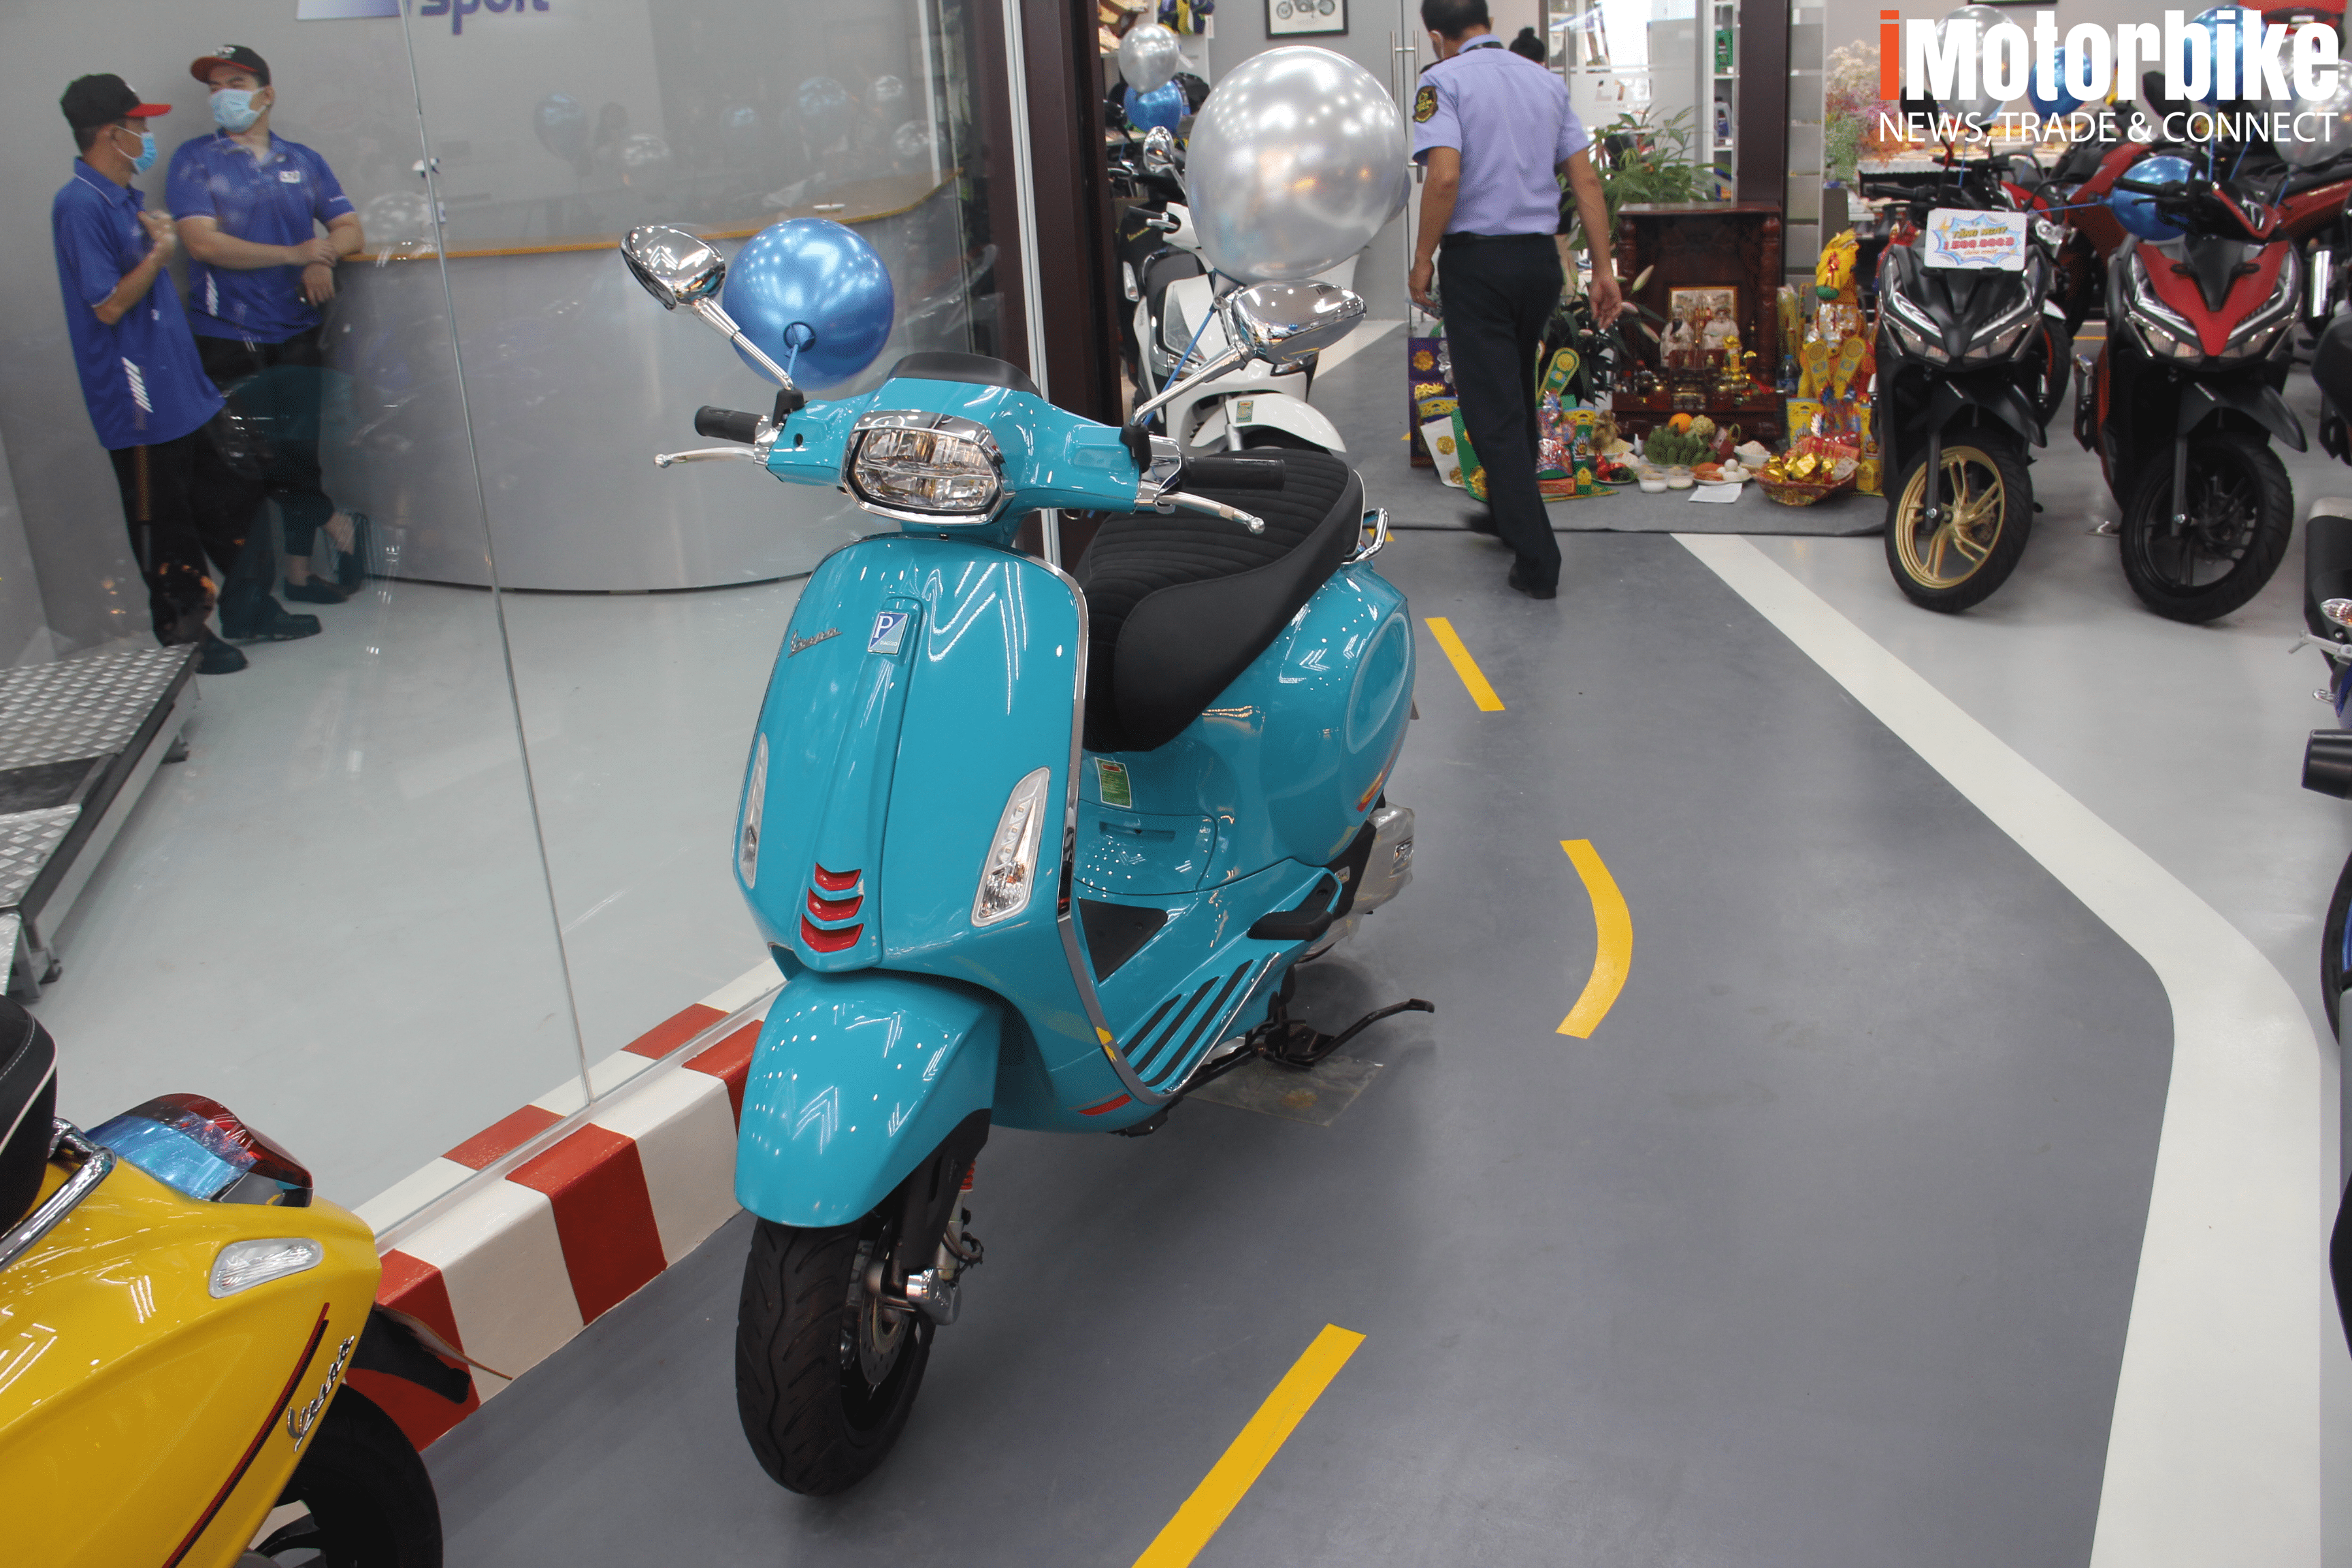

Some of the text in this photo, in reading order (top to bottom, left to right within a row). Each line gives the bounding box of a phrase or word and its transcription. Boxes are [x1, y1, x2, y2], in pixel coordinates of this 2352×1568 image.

[421, 0, 549, 35] spo
[787, 627, 843, 658] Vespa
[873, 615, 894, 638] P
[287, 1335, 355, 1453] Vespa
